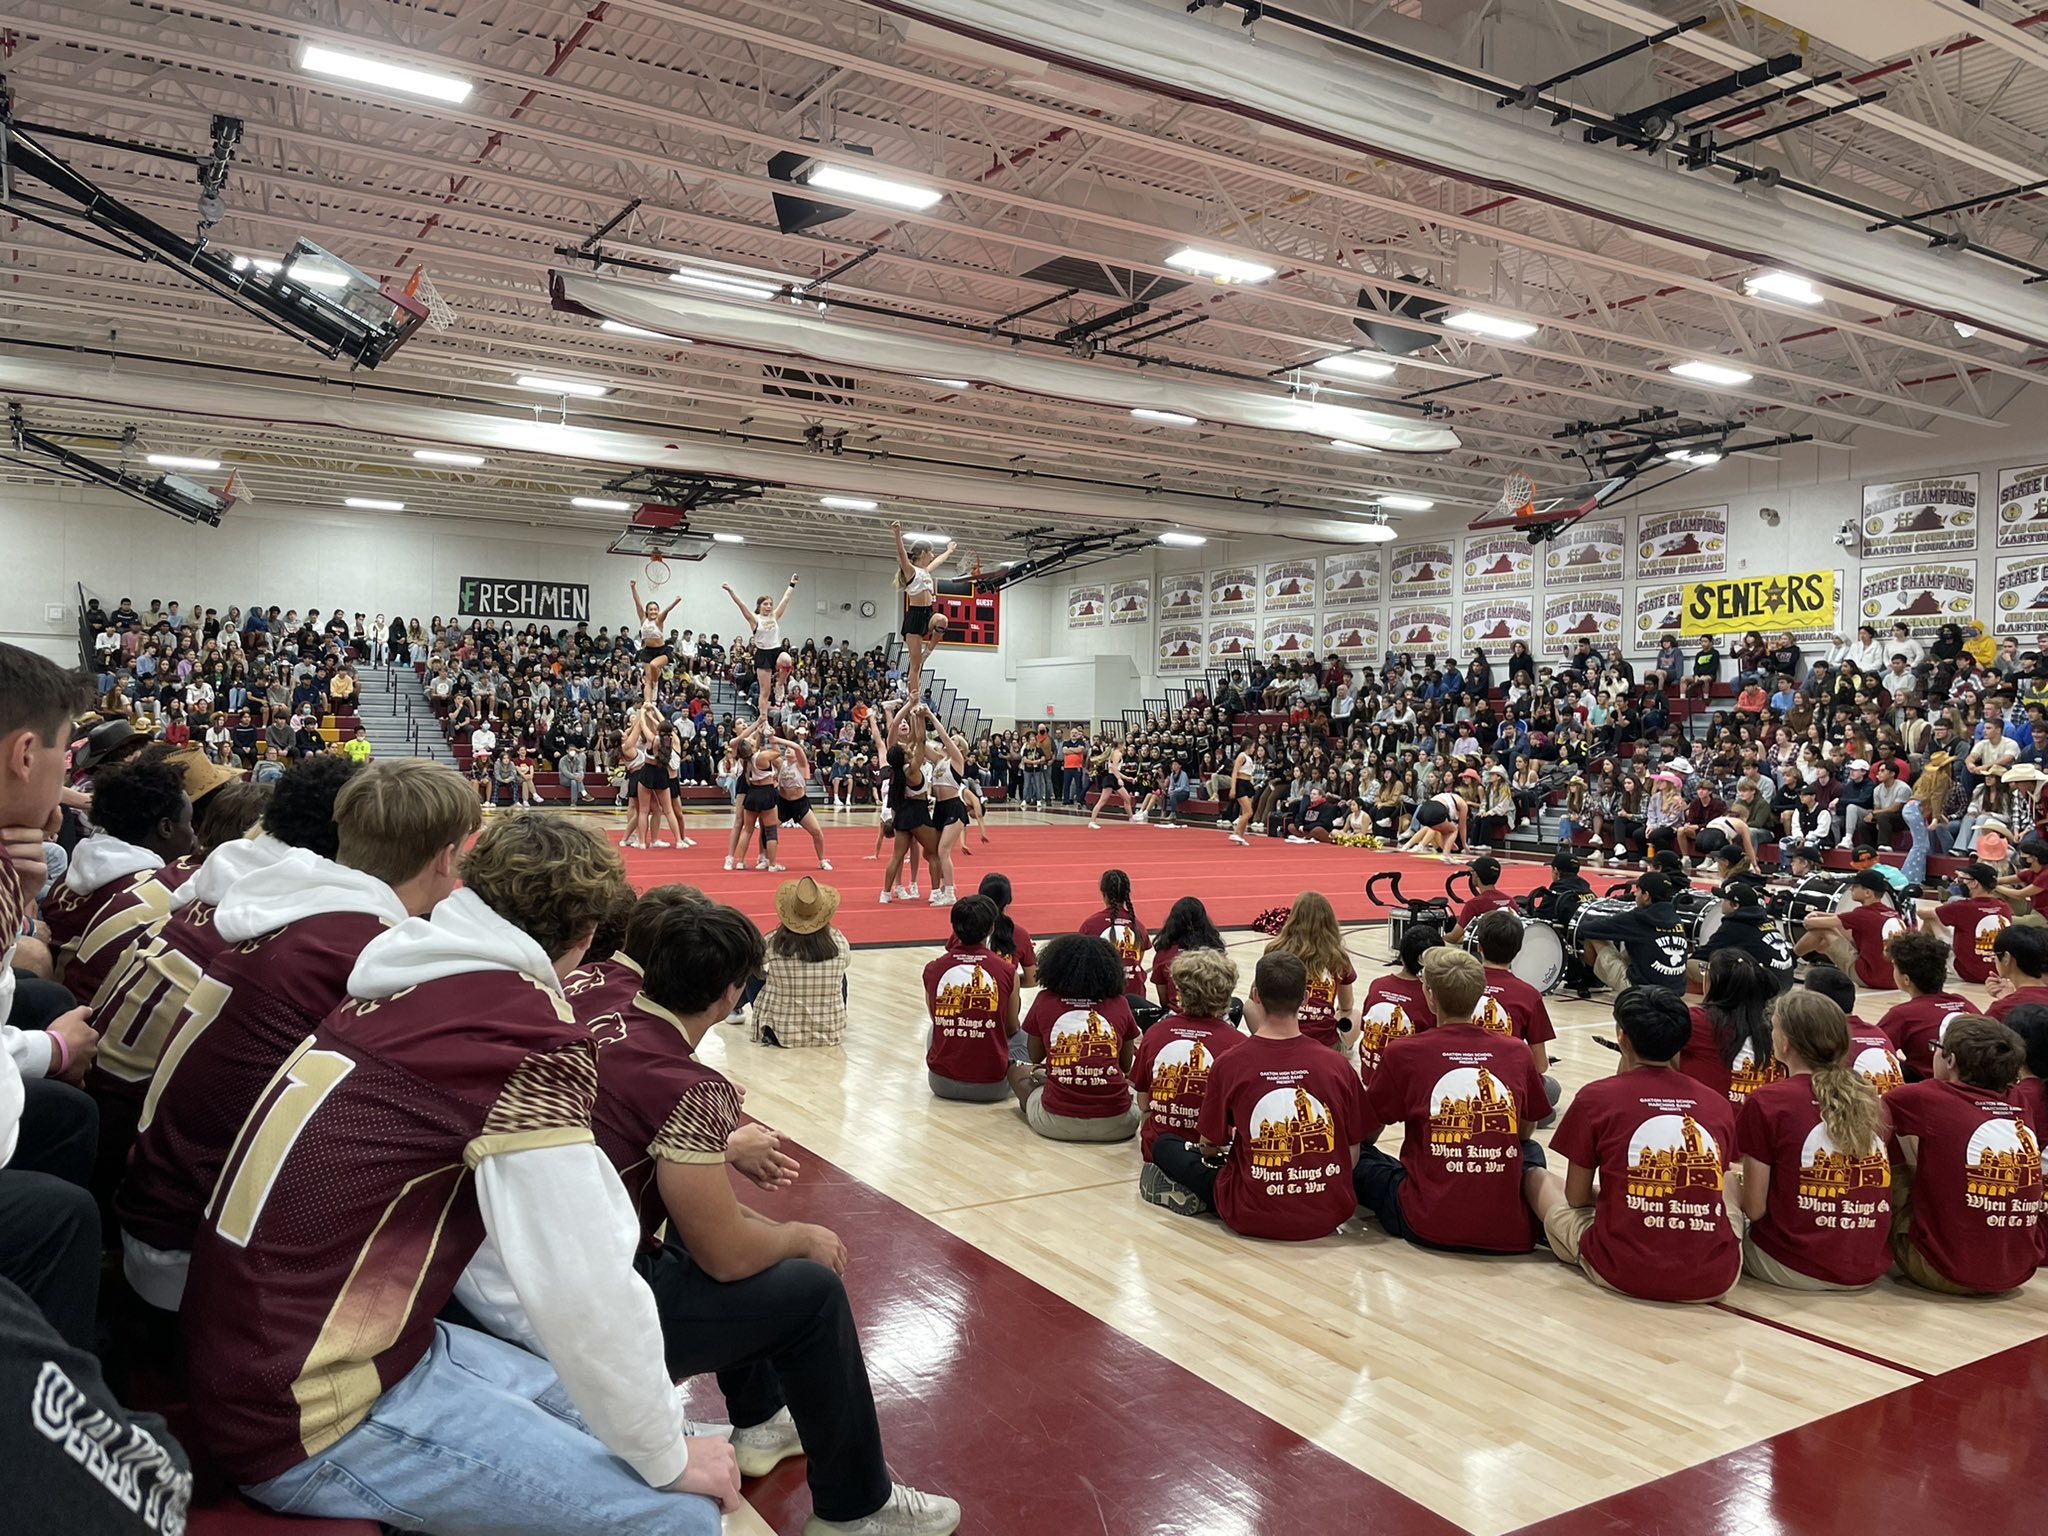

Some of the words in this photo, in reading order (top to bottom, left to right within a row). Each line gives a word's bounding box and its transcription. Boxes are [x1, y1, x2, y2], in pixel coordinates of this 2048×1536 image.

[1903, 489, 1976, 507] CHAMPIONS
[2000, 477, 2041, 505] STATE
[1669, 518, 1725, 535] CHAMPIONS
[1862, 577, 1899, 600] STATE
[1901, 574, 1974, 594] CHAMPIONS
[1997, 566, 2039, 592] STATE
[461, 580, 588, 619] FRESHMEN
[1637, 595, 1665, 615] STATE
[1545, 602, 1570, 621] STATE
[1571, 600, 1621, 617] CHAMPIONS
[935, 1015, 955, 1026] When
[957, 1017, 983, 1028] Kings
[957, 1028, 967, 1037] To
[969, 1029, 985, 1038] War
[1075, 1065, 1105, 1077] Kings
[1075, 1077, 1087, 1086] To
[1170, 1103, 1200, 1118] Kings
[1169, 1117, 1181, 1127] To
[1430, 1143, 1462, 1159] When
[1466, 1145, 1502, 1160] Kings
[1251, 1165, 1283, 1182] When
[1287, 1166, 1322, 1181] Kings
[1326, 1163, 1340, 1176] Go
[1446, 1161, 1463, 1173] Off
[1467, 1162, 1481, 1172] To
[1485, 1162, 1506, 1172] War
[1266, 1184, 1284, 1195] Off
[1287, 1183, 1301, 1194] To
[1305, 1182, 1326, 1193] War
[1626, 1194, 1663, 1215] When
[1669, 1200, 1710, 1217] Kings
[1797, 1195, 1836, 1213] When
[1841, 1199, 1875, 1215] Kings
[1965, 1193, 2006, 1212] When
[1644, 1215, 1665, 1228] Off
[1668, 1216, 1685, 1230] To
[1689, 1217, 1716, 1232] War
[1815, 1215, 1836, 1228] Off
[1840, 1217, 1856, 1229] To
[1986, 1215, 2007, 1227] Off
[2008, 1216, 2023, 1228] To
